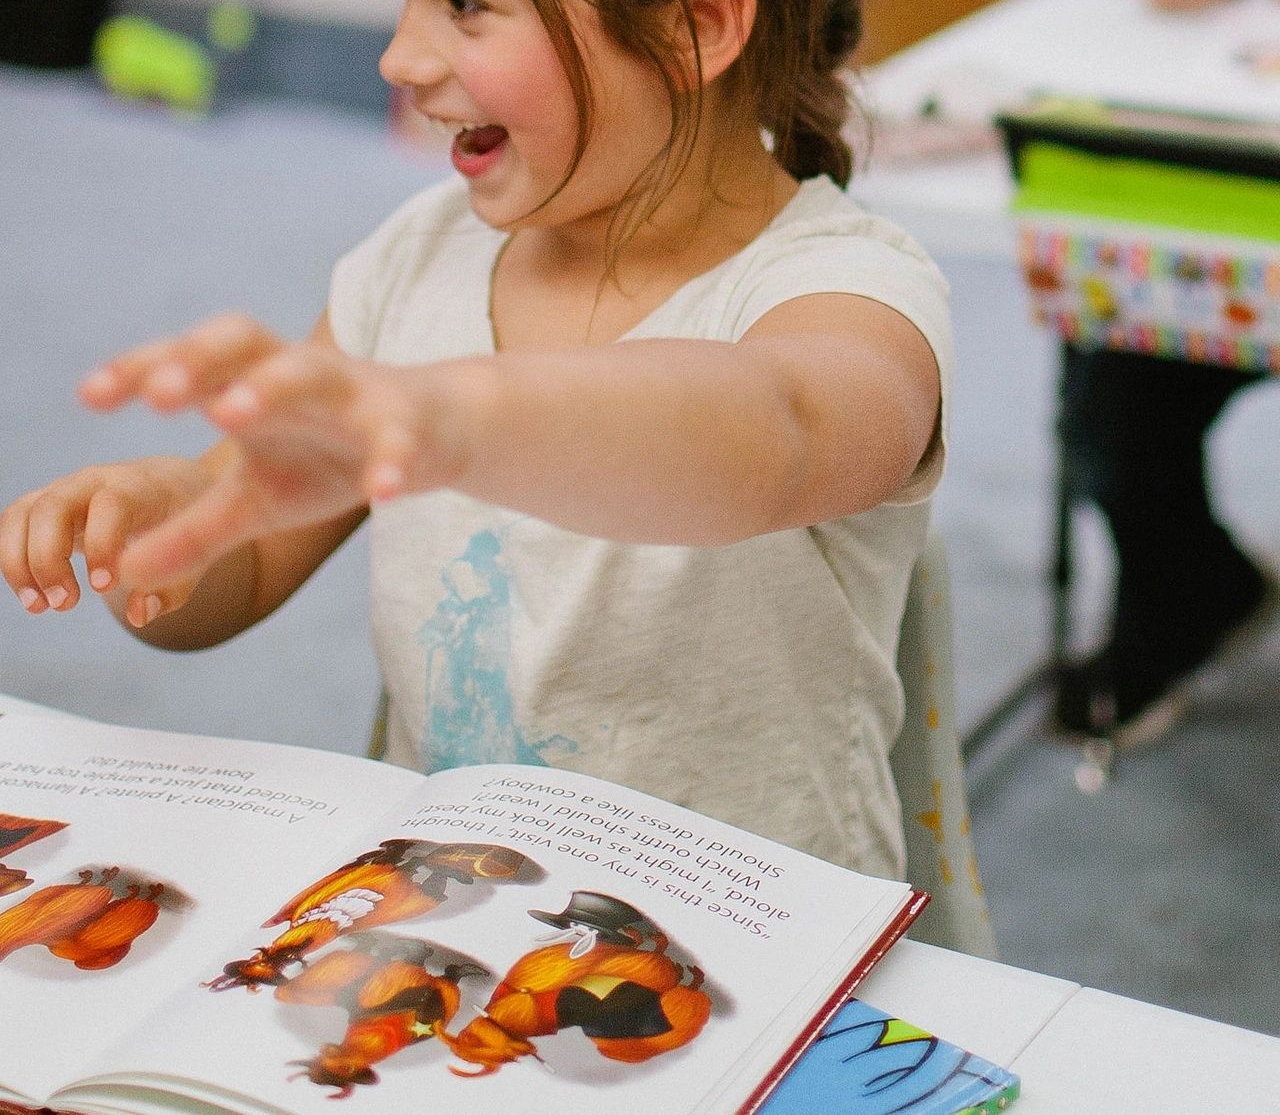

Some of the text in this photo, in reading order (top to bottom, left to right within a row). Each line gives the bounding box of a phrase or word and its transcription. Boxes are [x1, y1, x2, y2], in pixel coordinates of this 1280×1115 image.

[47, 766, 81, 778] top
[116, 760, 178, 771] would
[182, 766, 208, 774] tie
[83, 771, 144, 784] simple
[162, 776, 207, 789] just
[210, 769, 255, 782] bow
[79, 786, 97, 795] A
[202, 781, 243, 795] that
[482, 778, 576, 799] cowboy?
[166, 794, 183, 802] A
[181, 795, 285, 817] magician?
[242, 787, 327, 812] decided
[471, 791, 539, 807] wear?!
[581, 795, 594, 804] a
[417, 804, 469, 815] best!
[471, 805, 506, 818] my
[597, 801, 634, 820] like
[288, 813, 305, 824] A
[401, 817, 484, 832] thought
[508, 812, 556, 832] look
[553, 807, 629, 835] should
[556, 826, 602, 845] well
[638, 815, 693, 840] dress
[606, 842, 631, 855] as
[630, 831, 690, 858] outfit
[557, 844, 599, 862] one
[706, 841, 785, 878] Should
[602, 860, 637, 877] my
[633, 851, 700, 883] might
[694, 855, 760, 891] Which
[640, 875, 659, 888] is
[662, 884, 702, 906] this
[724, 887, 790, 921] aloud,
